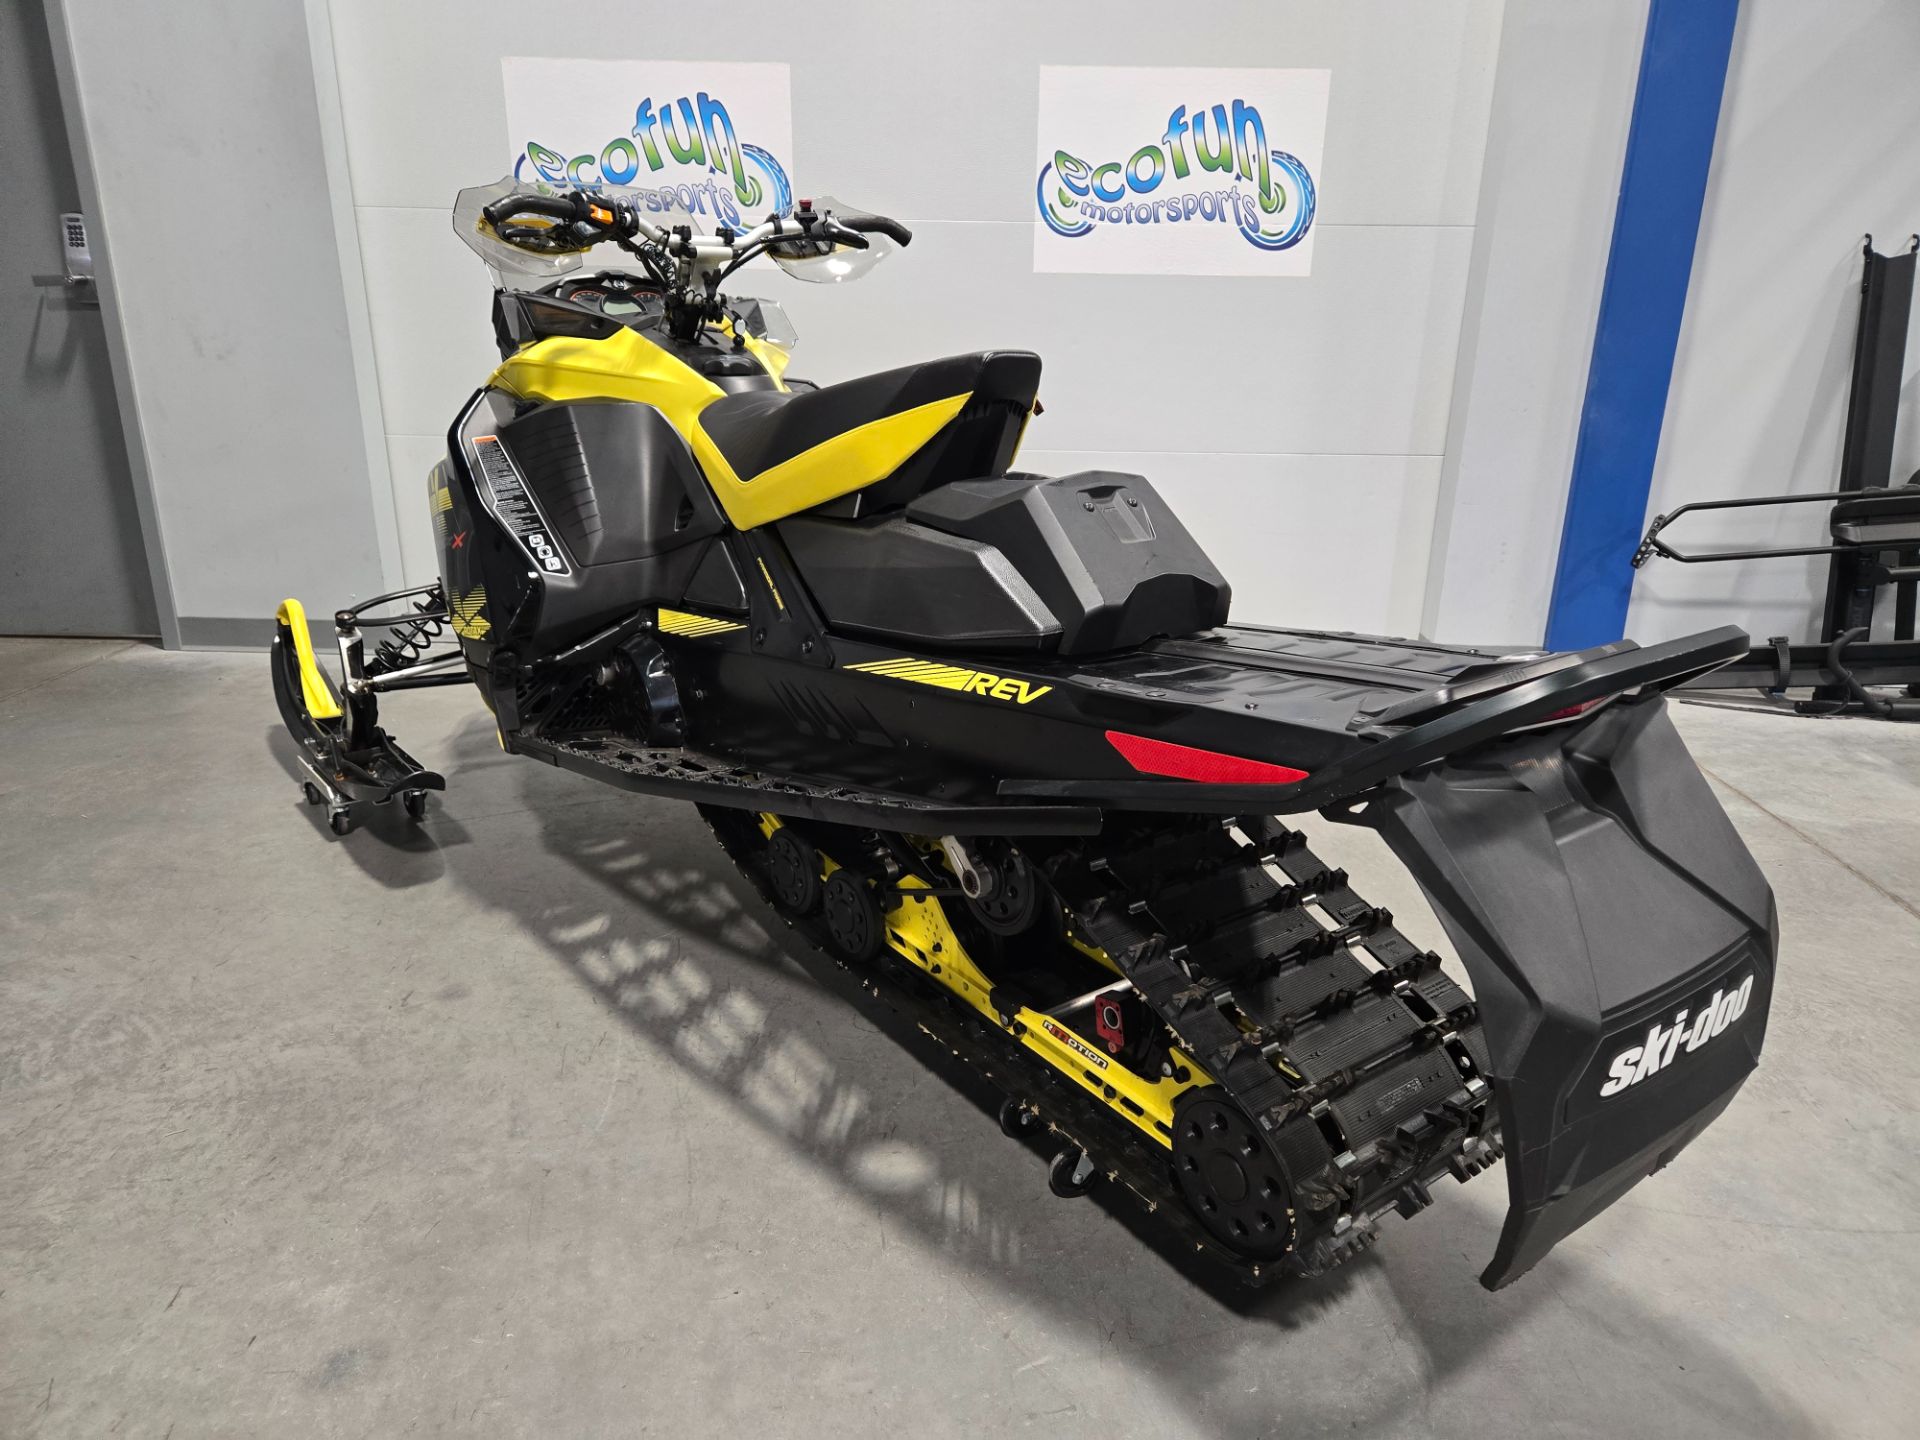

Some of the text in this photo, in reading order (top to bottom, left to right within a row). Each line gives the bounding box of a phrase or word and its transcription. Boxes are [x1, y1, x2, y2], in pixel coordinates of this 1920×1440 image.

[526, 91, 748, 194] ecofun
[1054, 98, 1271, 203] ecofun
[1080, 185, 1261, 234] motorsports
[963, 671, 1053, 705] REV
[1599, 974, 1754, 1097] ski-doo
